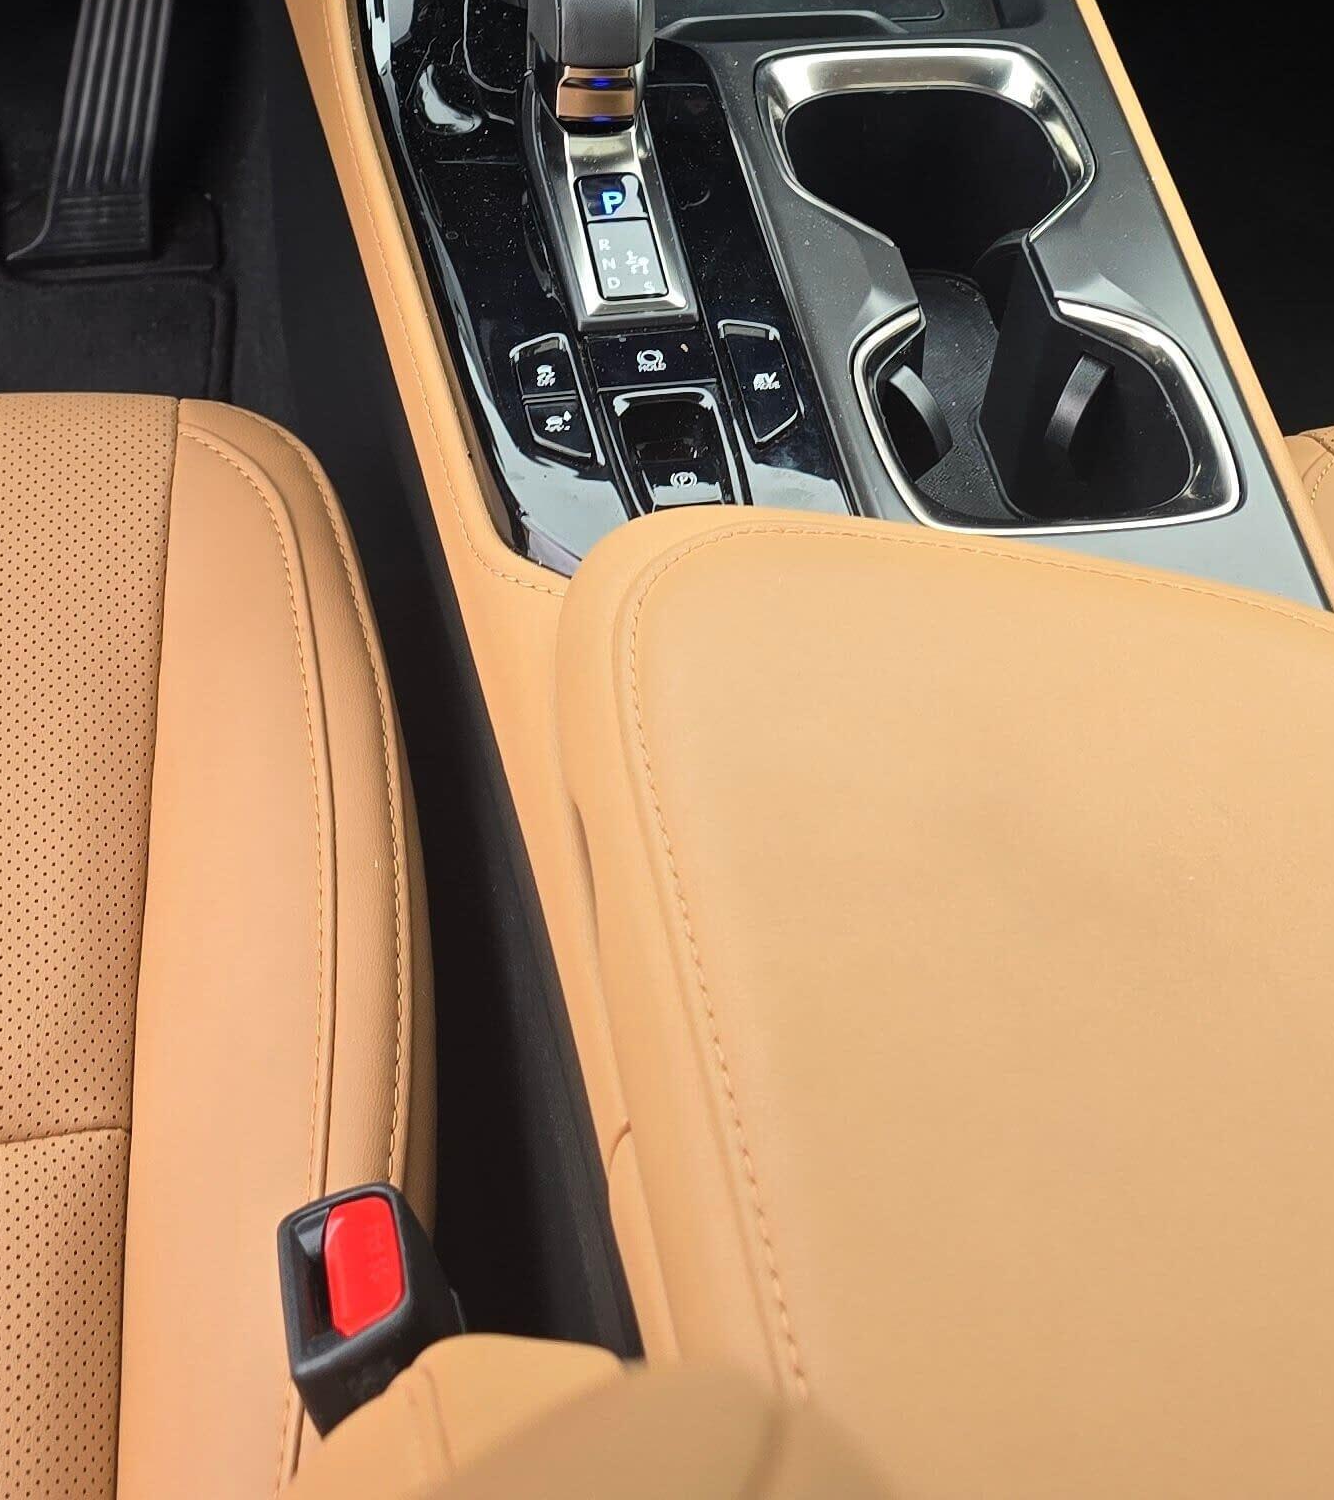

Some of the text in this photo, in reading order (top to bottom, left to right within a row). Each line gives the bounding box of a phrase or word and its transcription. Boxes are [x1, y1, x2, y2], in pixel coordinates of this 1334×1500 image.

[602, 190, 623, 215] P
[598, 238, 611, 251] R
[601, 257, 617, 271] N
[607, 276, 621, 290] D
[644, 281, 656, 294] S
